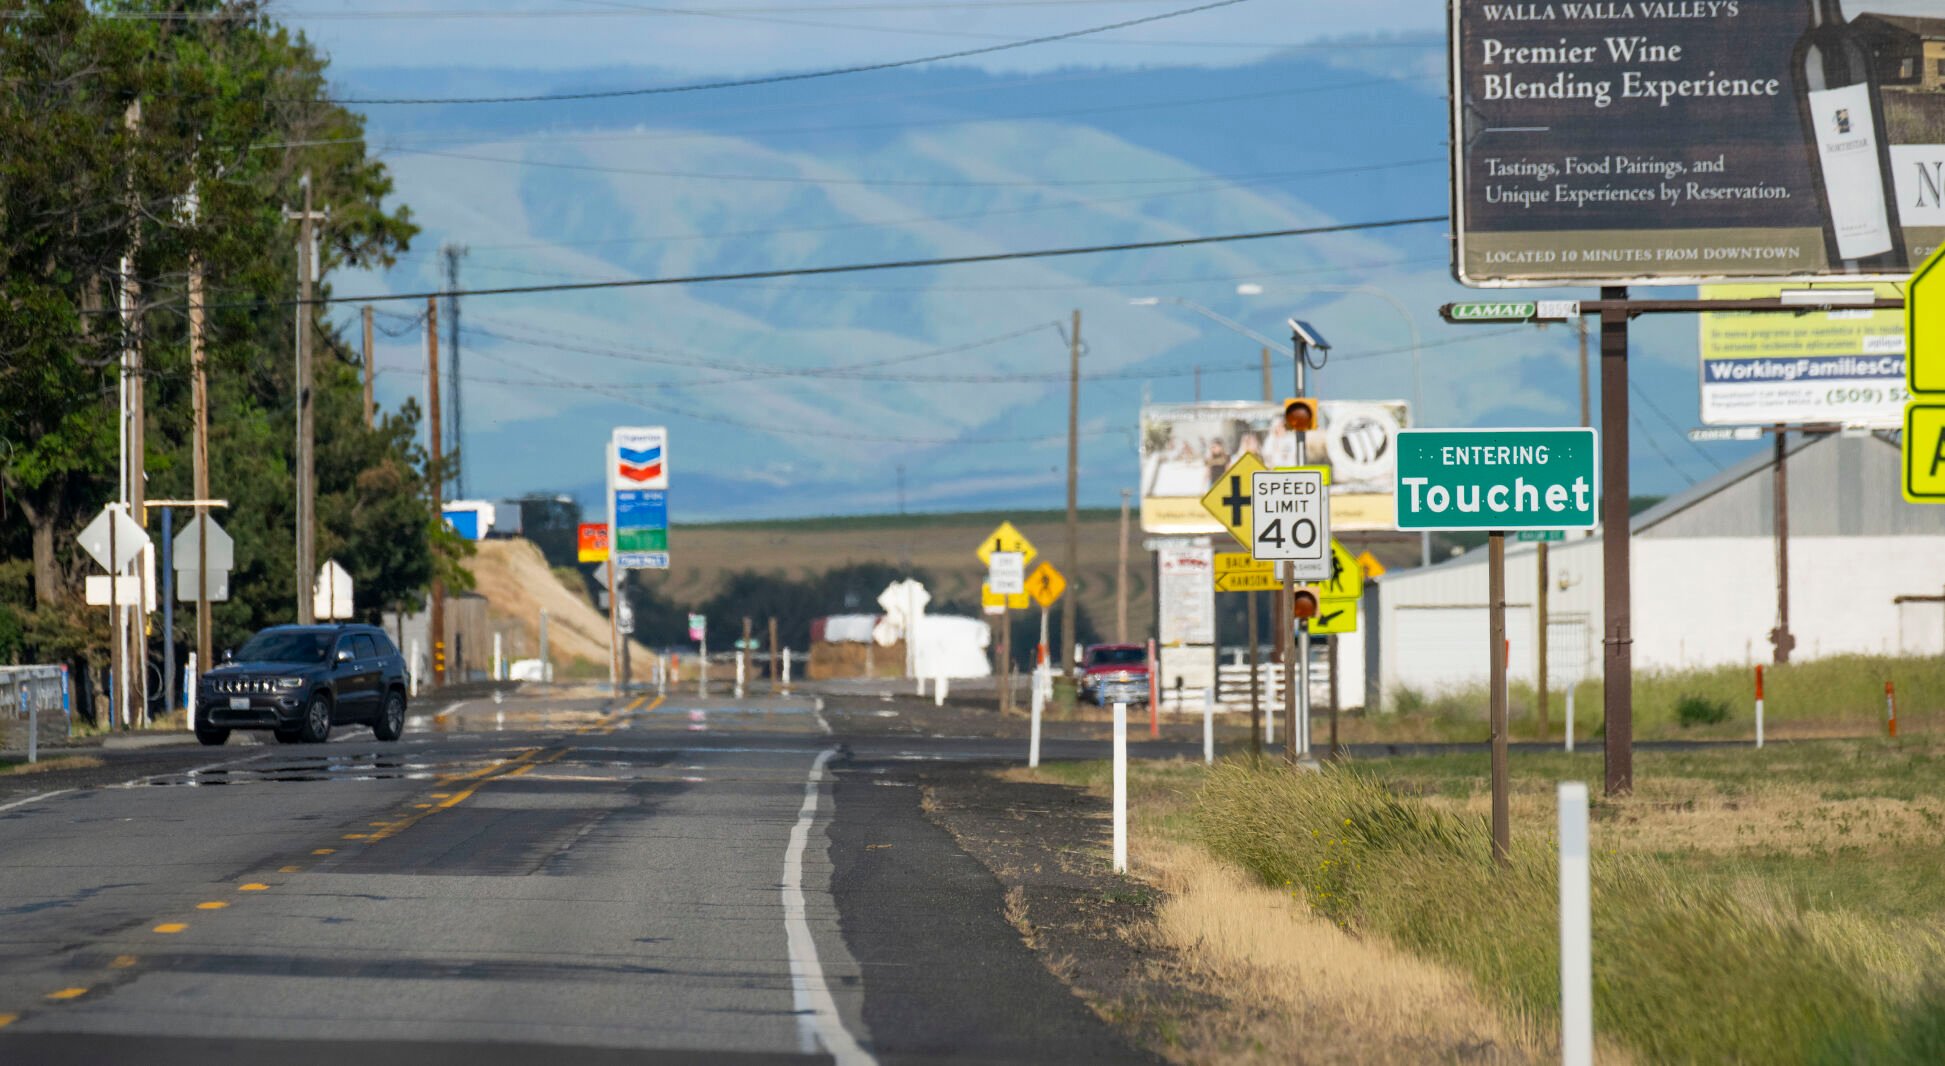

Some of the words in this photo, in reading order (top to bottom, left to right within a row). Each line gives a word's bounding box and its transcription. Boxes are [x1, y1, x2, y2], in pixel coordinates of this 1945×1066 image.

[1483, 4, 1556, 21] WALLA
[1562, 3, 1635, 19] WALLA
[1641, 1, 1739, 18] VALLEY'S
[1482, 38, 1597, 65] Premier
[1604, 36, 1682, 63] Wine
[1483, 72, 1612, 108] Blending
[1622, 70, 1780, 107] Experience
[1484, 157, 1560, 181] Tastings,
[1565, 156, 1610, 175] Food
[1615, 155, 1688, 180] Pairings,
[1693, 153, 1725, 173] and
[1486, 184, 1550, 209] Unique
[1555, 183, 1655, 208] Experiences
[1660, 182, 1681, 207] by
[1686, 181, 1791, 200] Reservation.
[1486, 250, 1556, 263] LOCATED
[1561, 249, 1578, 262] 10
[1582, 248, 1652, 263] MINUTES
[1656, 248, 1698, 261] FROM
[1703, 246, 1800, 260] DOWNTOWN
[1459, 304, 1528, 318] LAMAR
[1826, 387, 1882, 405] (509)
[1442, 445, 1549, 465] ENTERING
[1258, 482, 1316, 495] SPEED
[1402, 476, 1589, 513] Touchet
[1264, 500, 1309, 513] LIMIT
[1258, 518, 1317, 549] 40
[1229, 575, 1269, 586] HANSON
